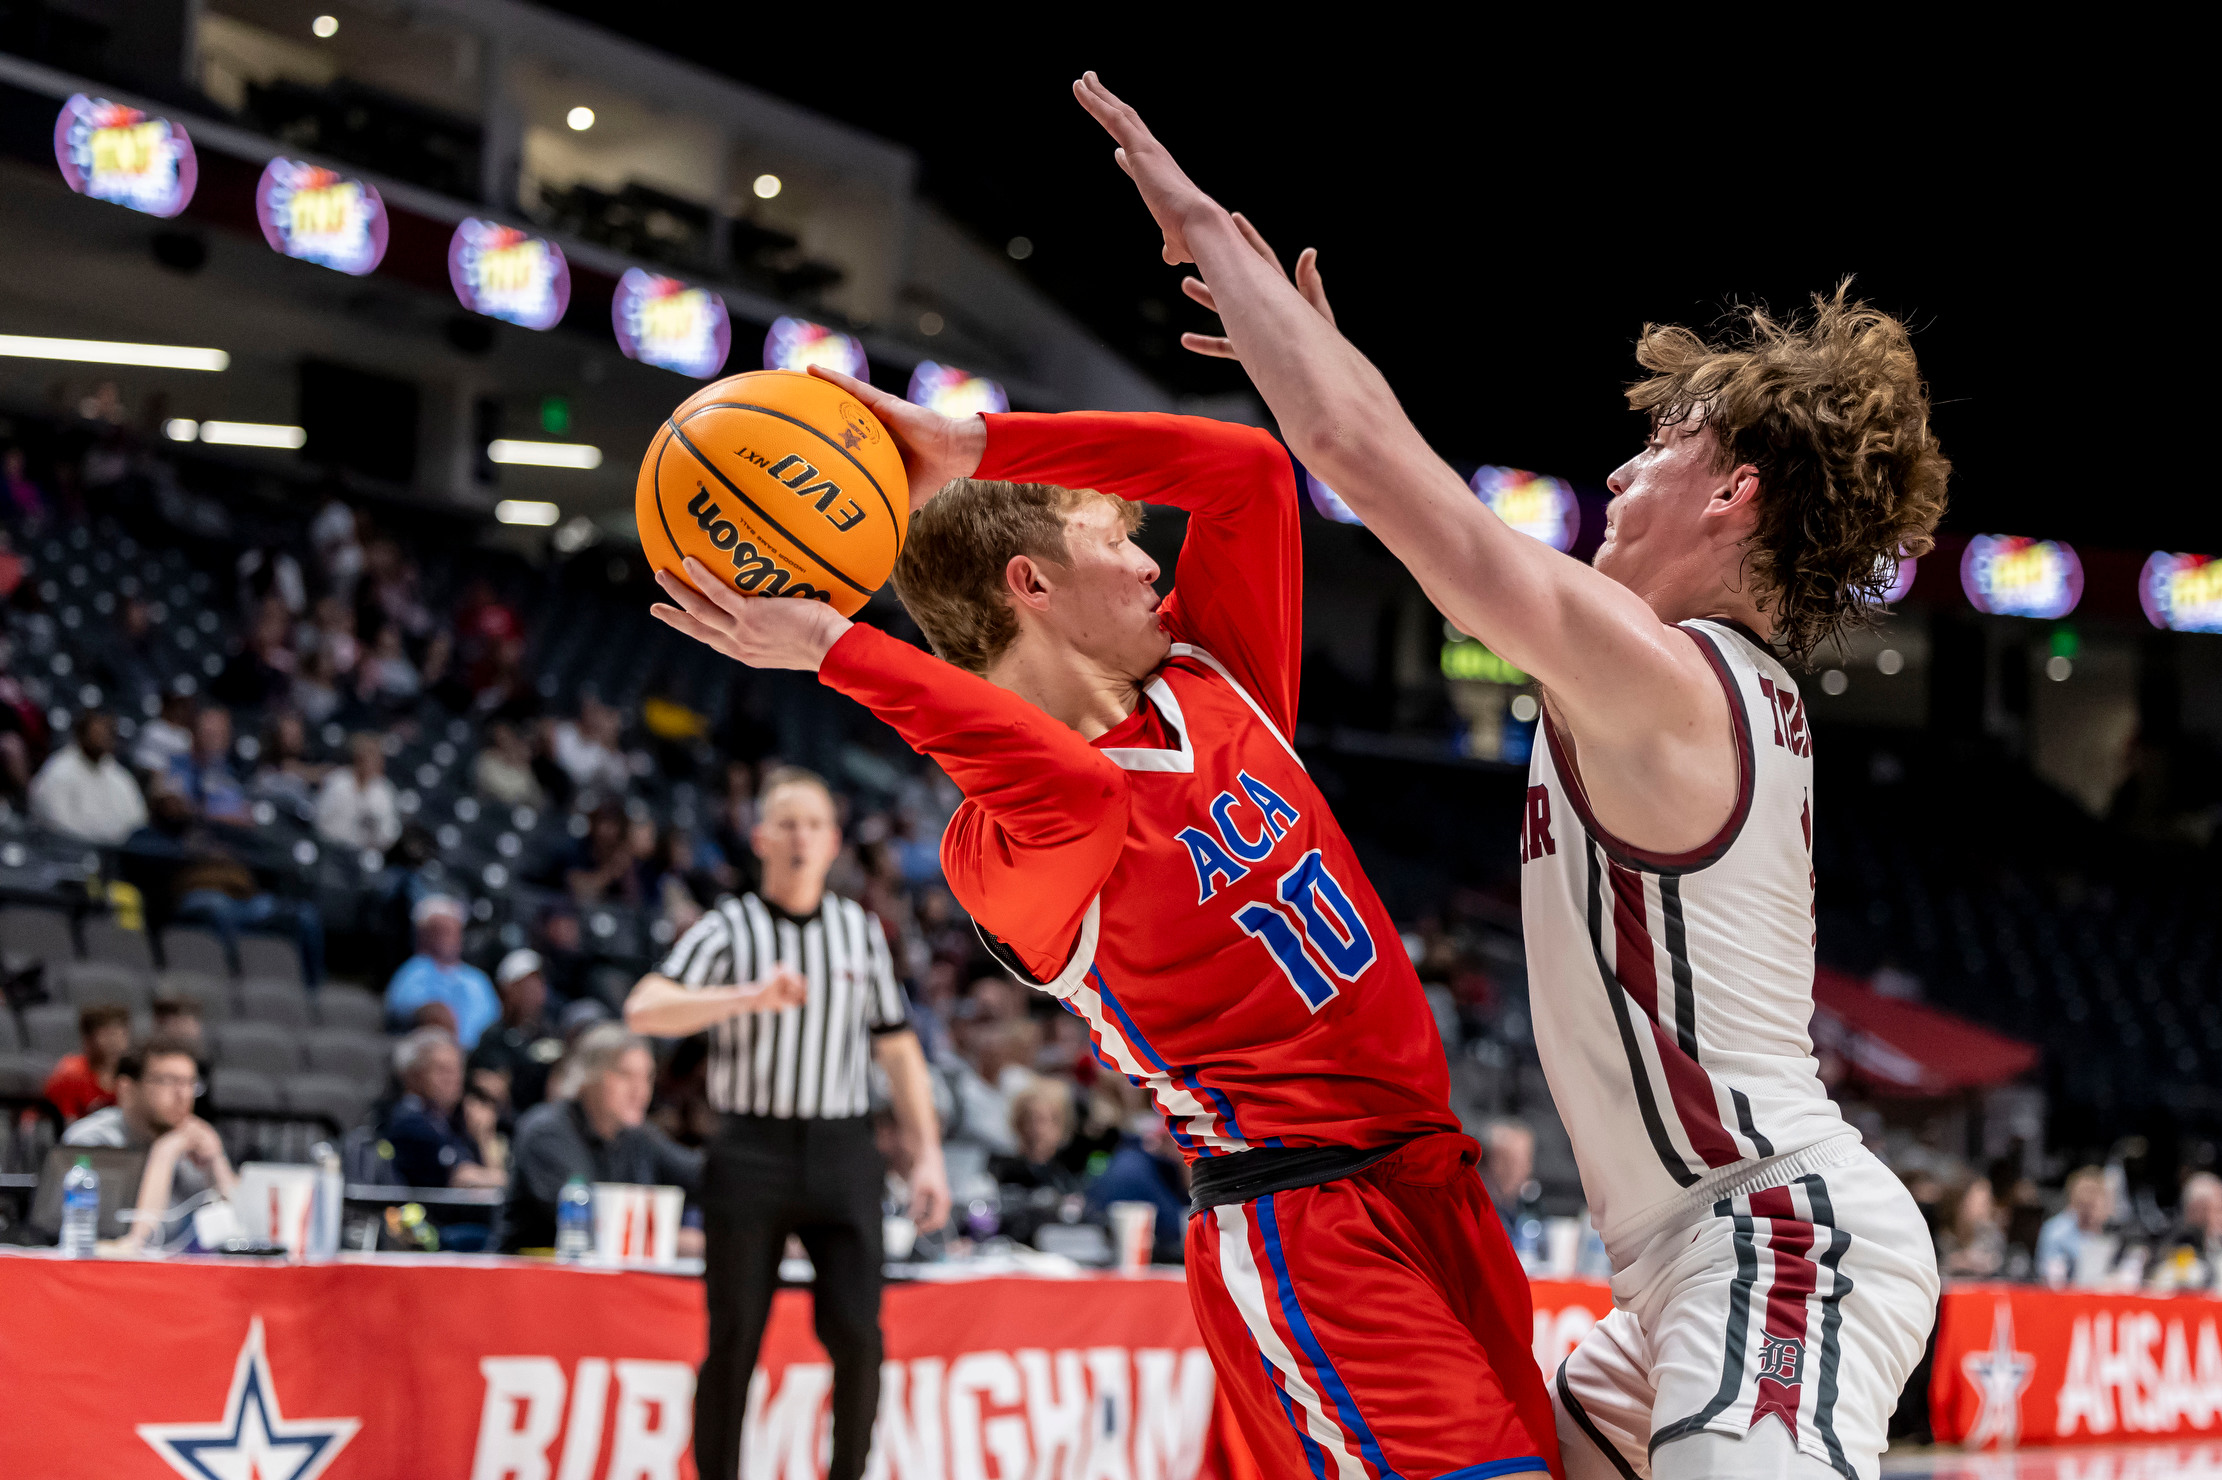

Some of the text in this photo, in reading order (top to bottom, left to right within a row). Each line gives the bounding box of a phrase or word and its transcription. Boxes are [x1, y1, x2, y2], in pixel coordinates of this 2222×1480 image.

[733, 447, 867, 532] EVO NXT
[739, 517, 808, 574] INDOOR GAME BALL
[1173, 768, 1300, 906] ACA
[1230, 848, 1378, 1016] 10
[468, 1346, 1216, 1480] BIRMNGHAM
